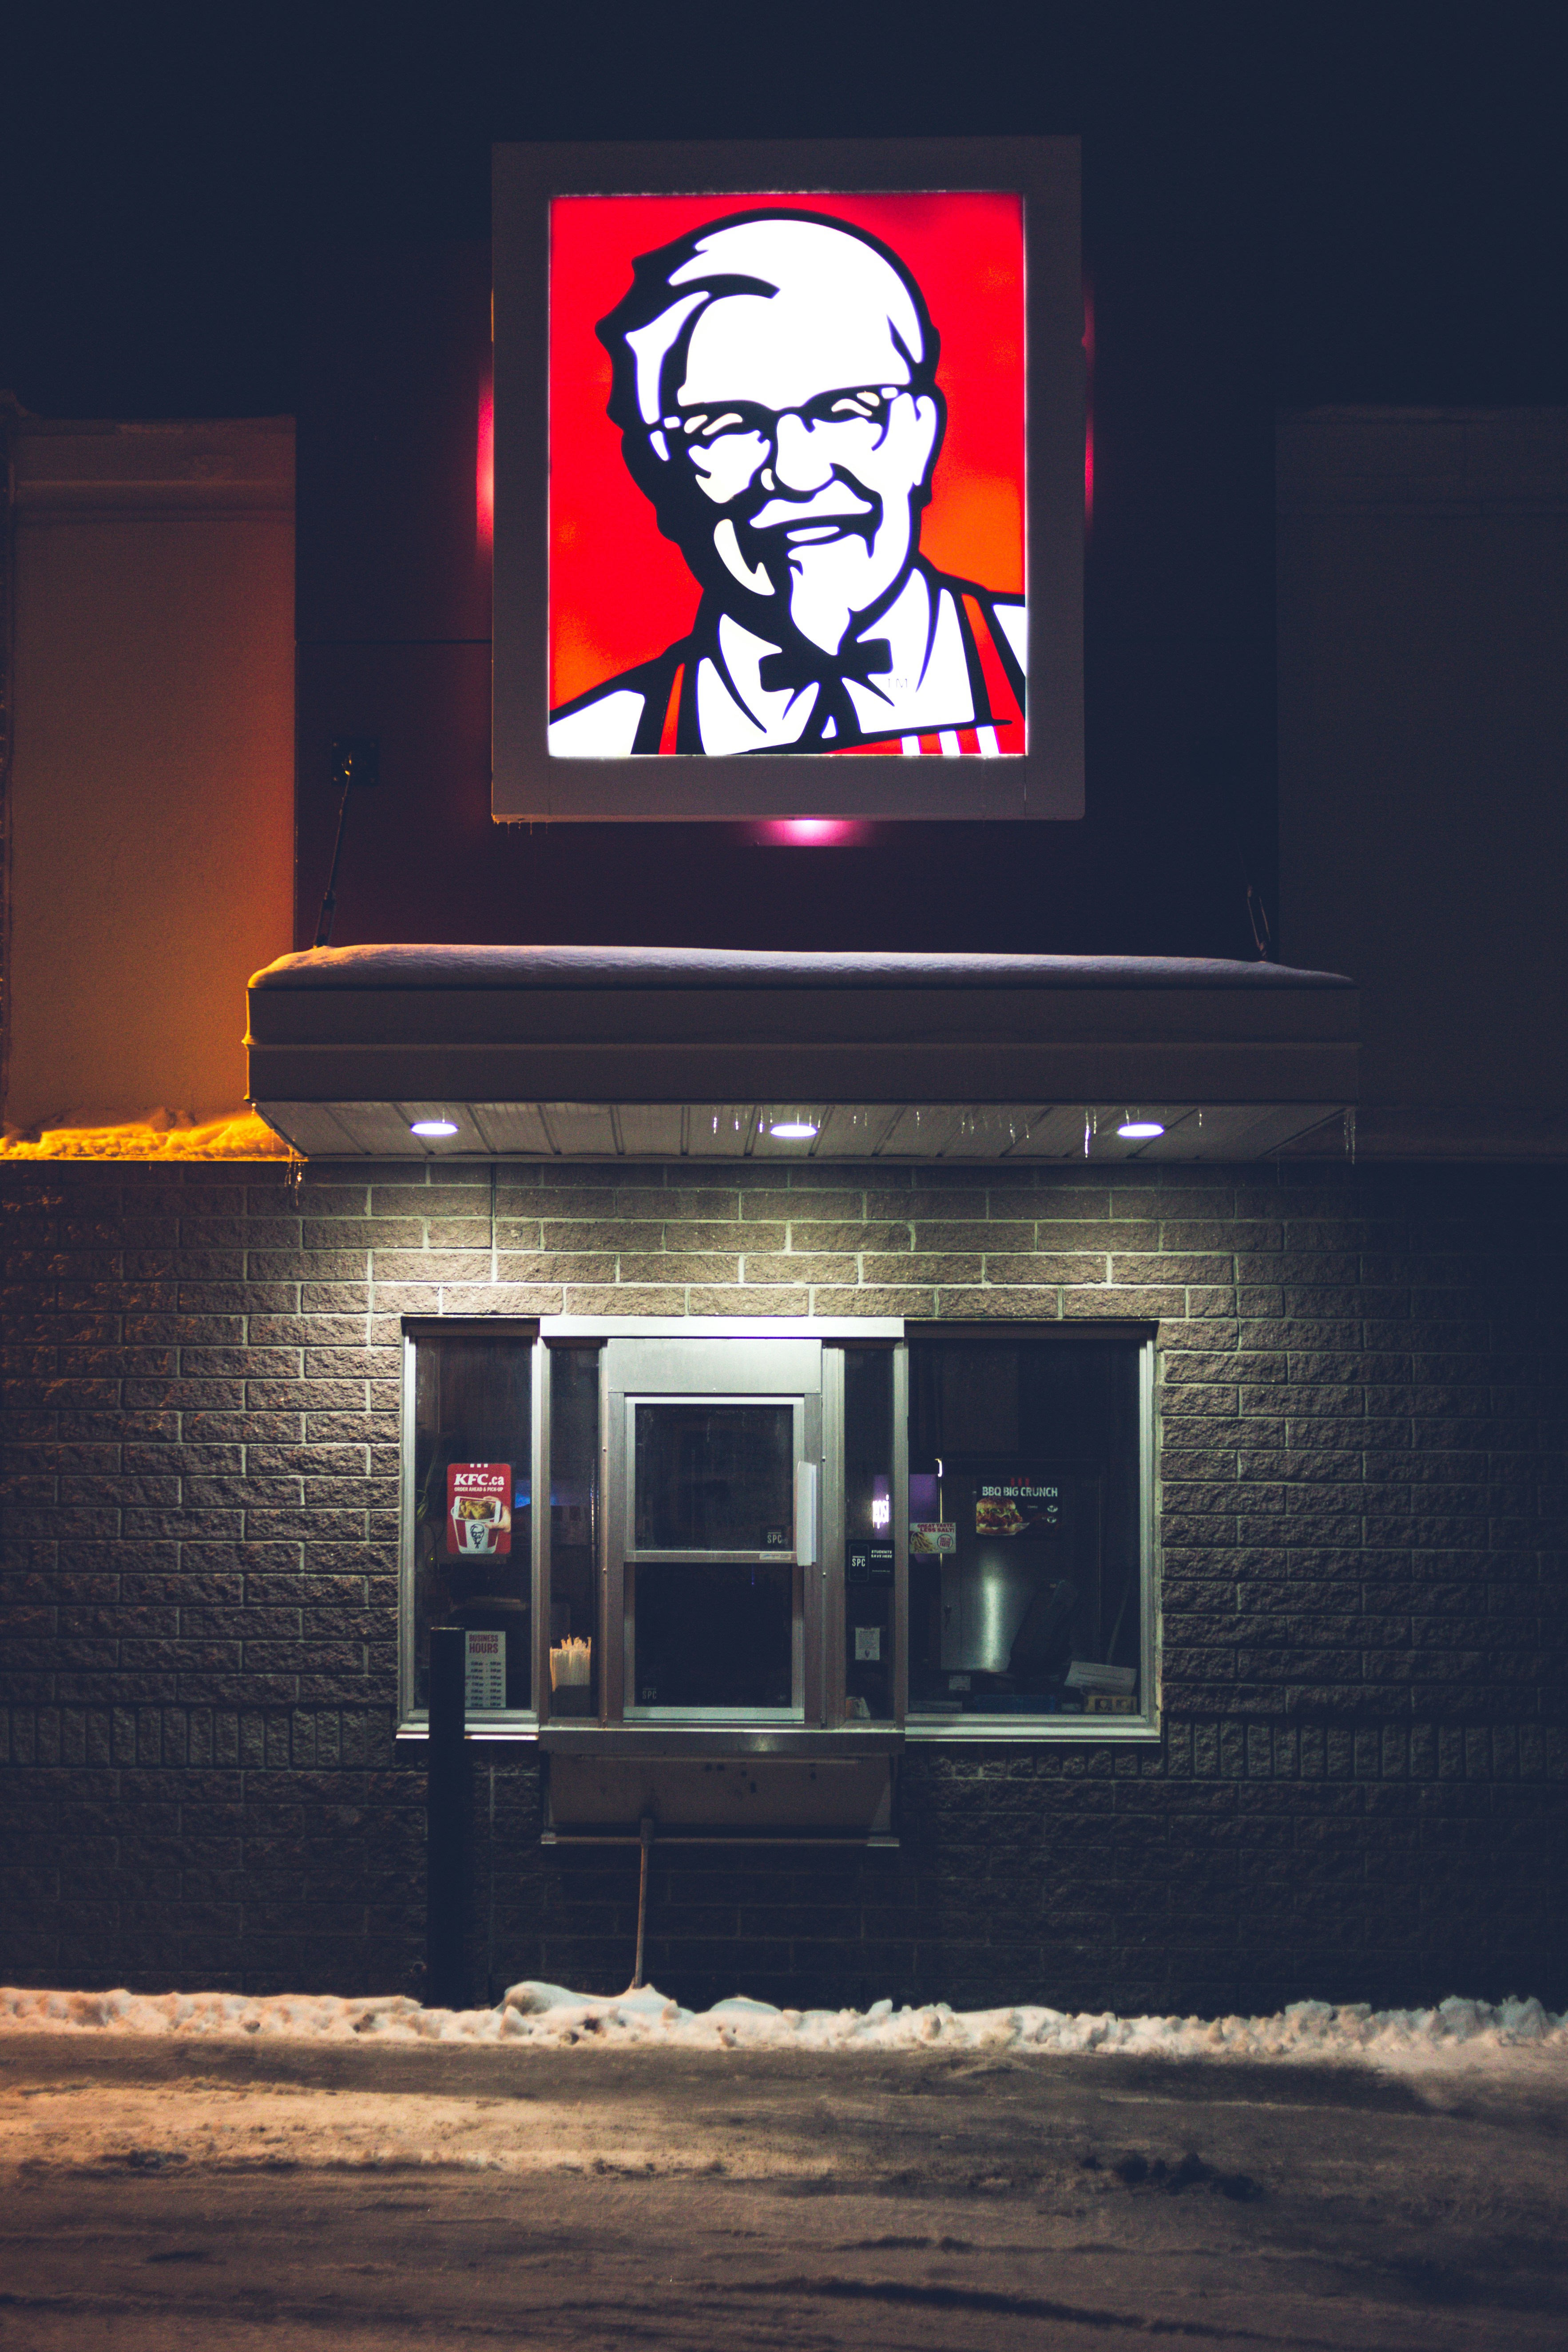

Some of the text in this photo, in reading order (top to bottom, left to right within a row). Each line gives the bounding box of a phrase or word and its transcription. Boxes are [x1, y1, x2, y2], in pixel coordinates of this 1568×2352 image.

[454, 1474, 504, 1485] KFC.ca
[982, 1486, 1058, 1497] BBQ BIG CRUNCH
[767, 1534, 782, 1543] SPC
[852, 1558, 865, 1566] SPC
[469, 1643, 498, 1653] HOURS
[642, 1690, 656, 1699] SPC
